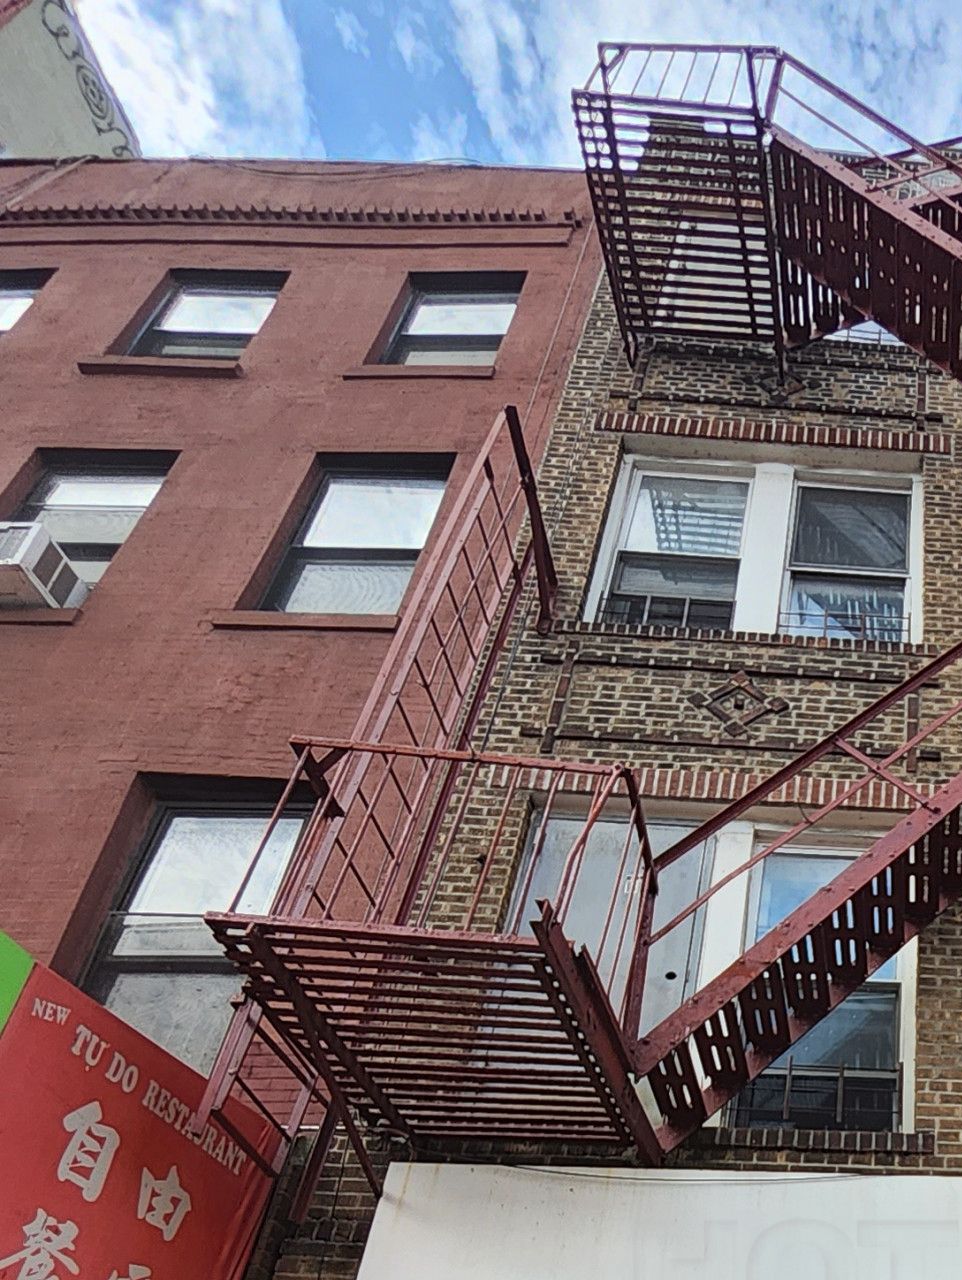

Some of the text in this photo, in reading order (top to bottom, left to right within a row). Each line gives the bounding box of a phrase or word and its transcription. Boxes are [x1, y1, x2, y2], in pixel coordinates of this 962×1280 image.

[32, 997, 71, 1025] NEW
[105, 1051, 139, 1093] DO
[141, 1079, 248, 1176] RESTAURANT
[57, 1101, 191, 1241] 自由
